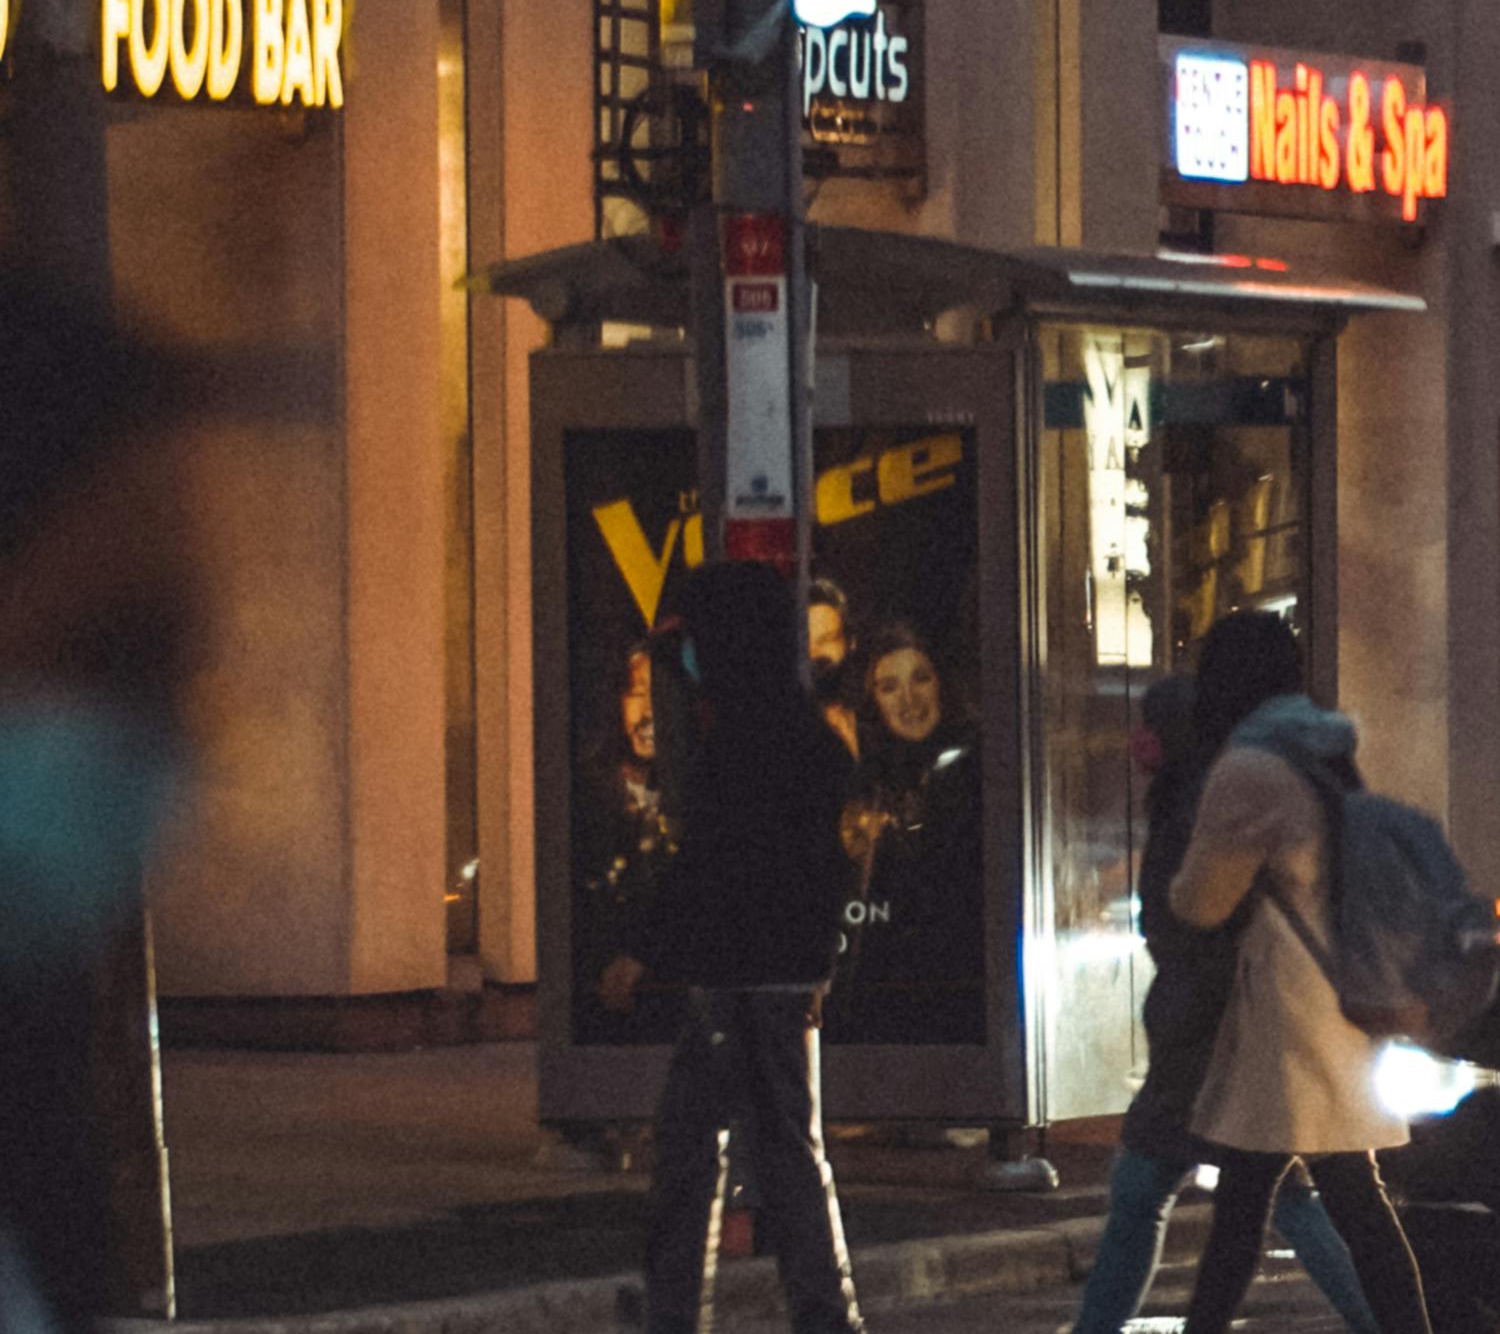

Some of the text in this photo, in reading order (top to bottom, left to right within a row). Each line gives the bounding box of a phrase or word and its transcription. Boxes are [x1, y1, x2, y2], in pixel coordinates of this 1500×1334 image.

[1249, 59, 1448, 222] Nails & Spa
